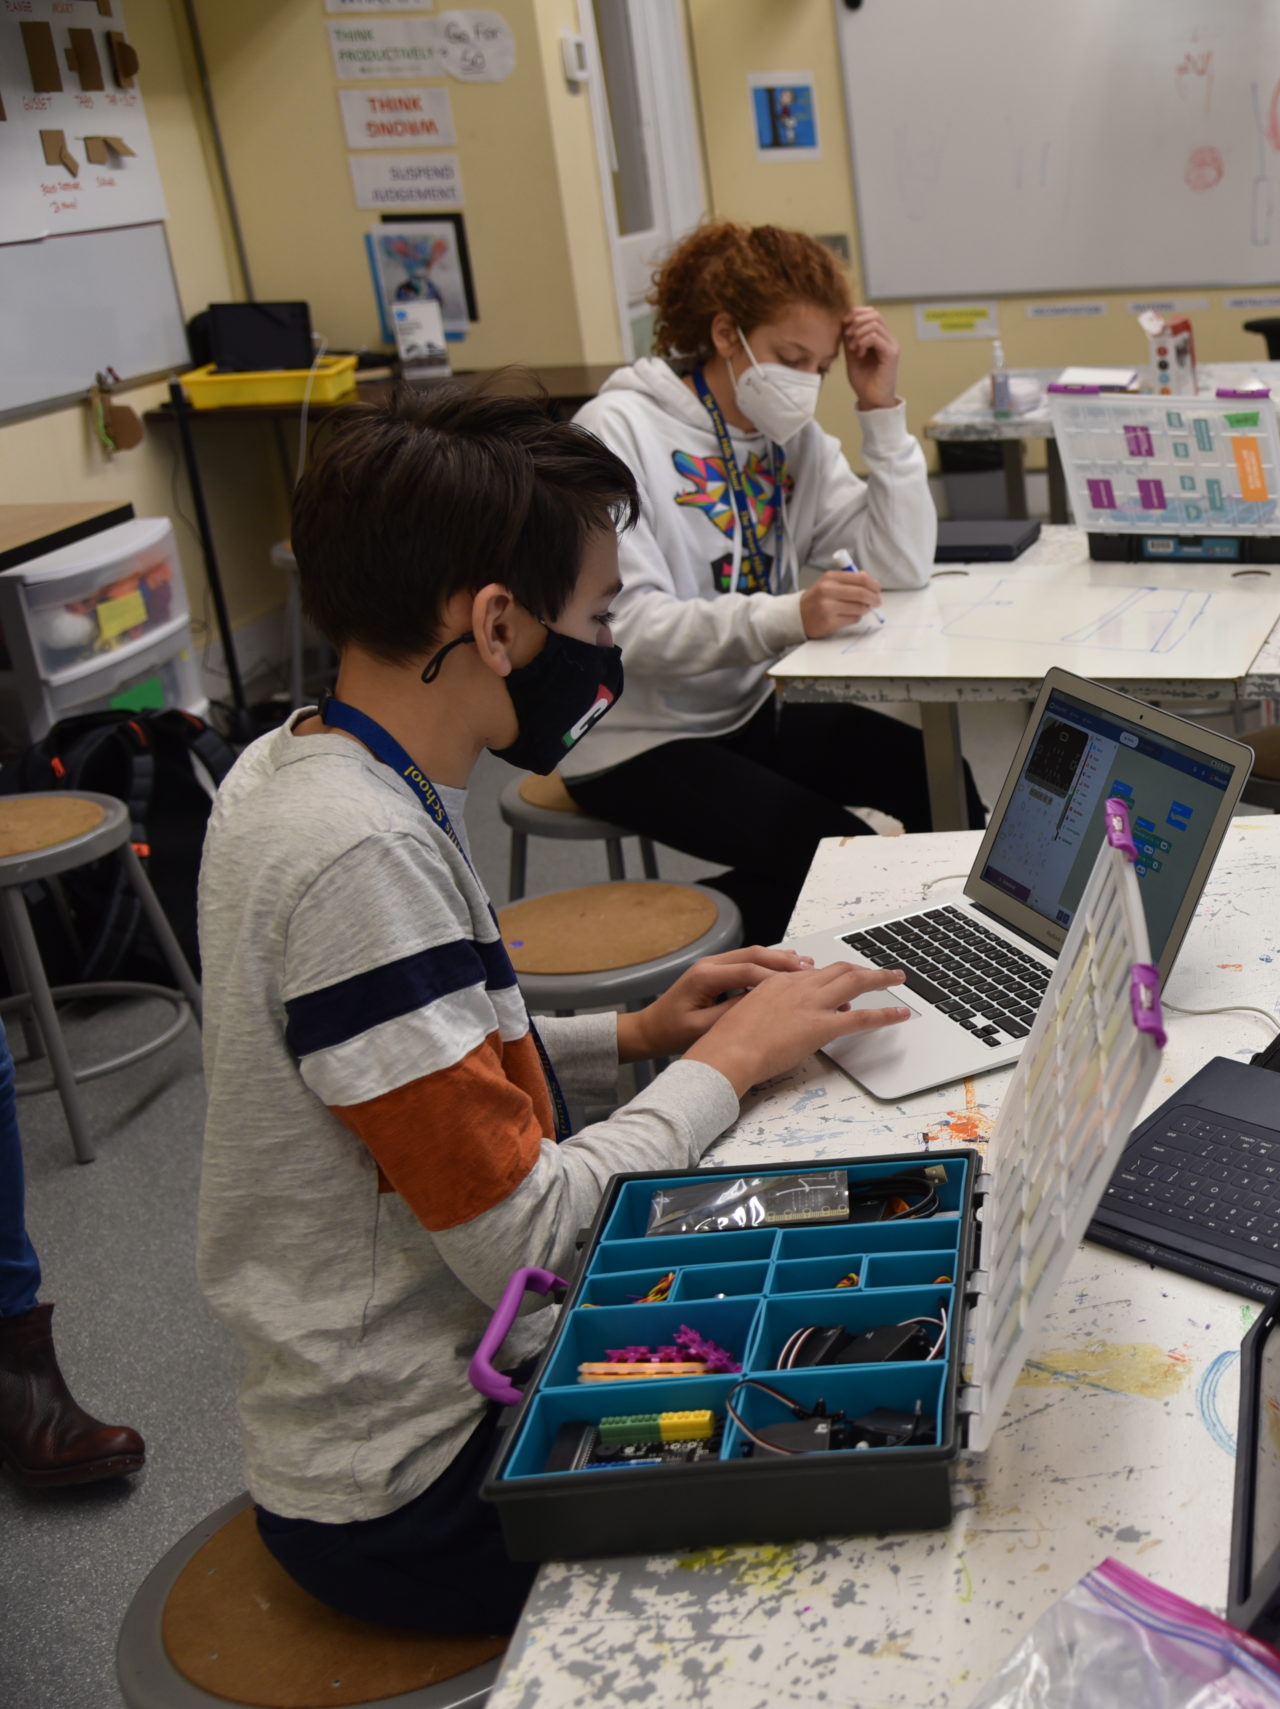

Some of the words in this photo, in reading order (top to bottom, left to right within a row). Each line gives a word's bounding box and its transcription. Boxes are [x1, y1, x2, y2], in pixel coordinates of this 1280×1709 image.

[338, 47, 434, 63] PRODUCTIVELY
[366, 95, 424, 113] THINK
[389, 164, 456, 181] SUSPEND
[404, 765, 446, 822] School
